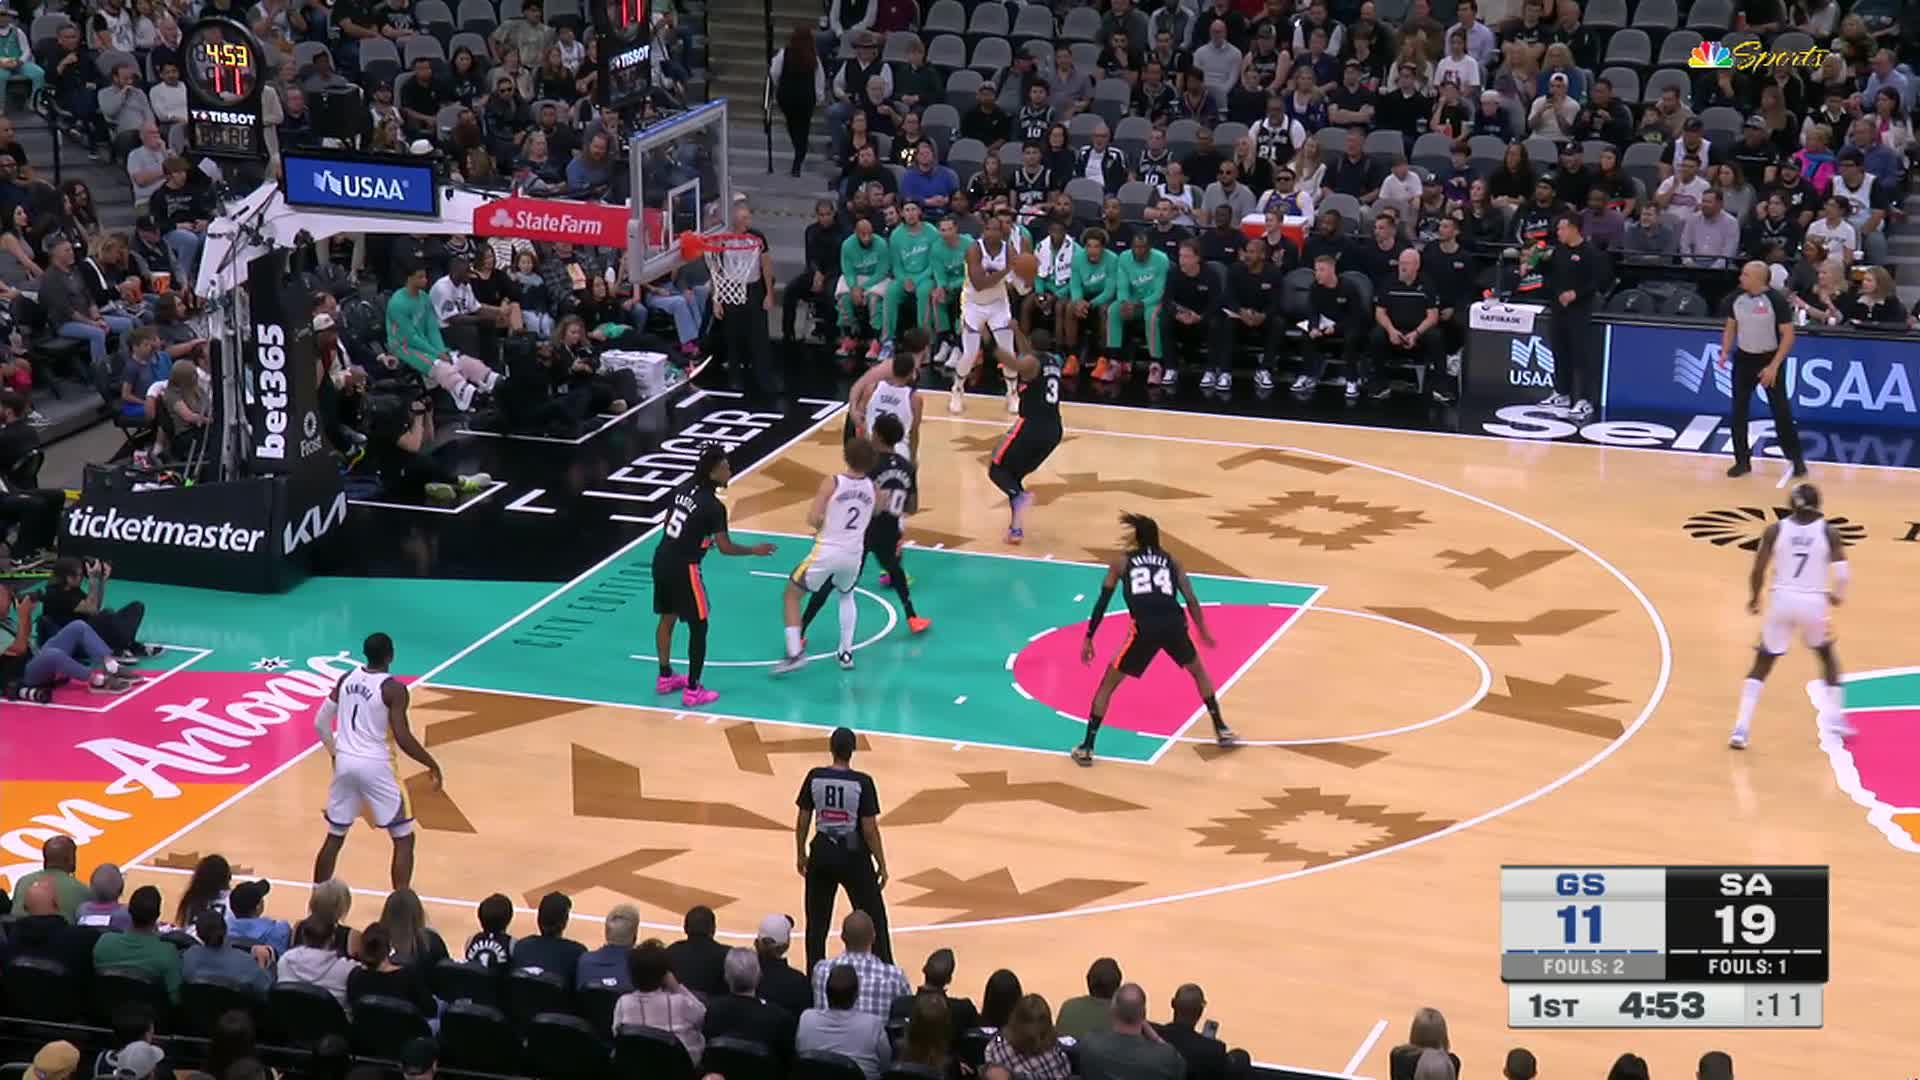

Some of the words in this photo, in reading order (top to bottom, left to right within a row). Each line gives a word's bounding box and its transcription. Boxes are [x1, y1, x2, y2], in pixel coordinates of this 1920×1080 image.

[206, 43, 247, 67] 4:53
[214, 66, 240, 96] 11
[208, 110, 255, 125] TISSOT
[344, 175, 404, 200] USAA
[1046, 377, 1059, 404] 3
[1509, 369, 1554, 387] USAA
[256, 324, 287, 459] bet365
[582, 409, 784, 501] LEDGER
[68, 506, 265, 553] ticketmaster
[666, 509, 687, 538] 5
[844, 506, 861, 530] 2
[1791, 552, 1808, 578] 7
[1130, 567, 1173, 596] 24
[825, 785, 845, 808] 81
